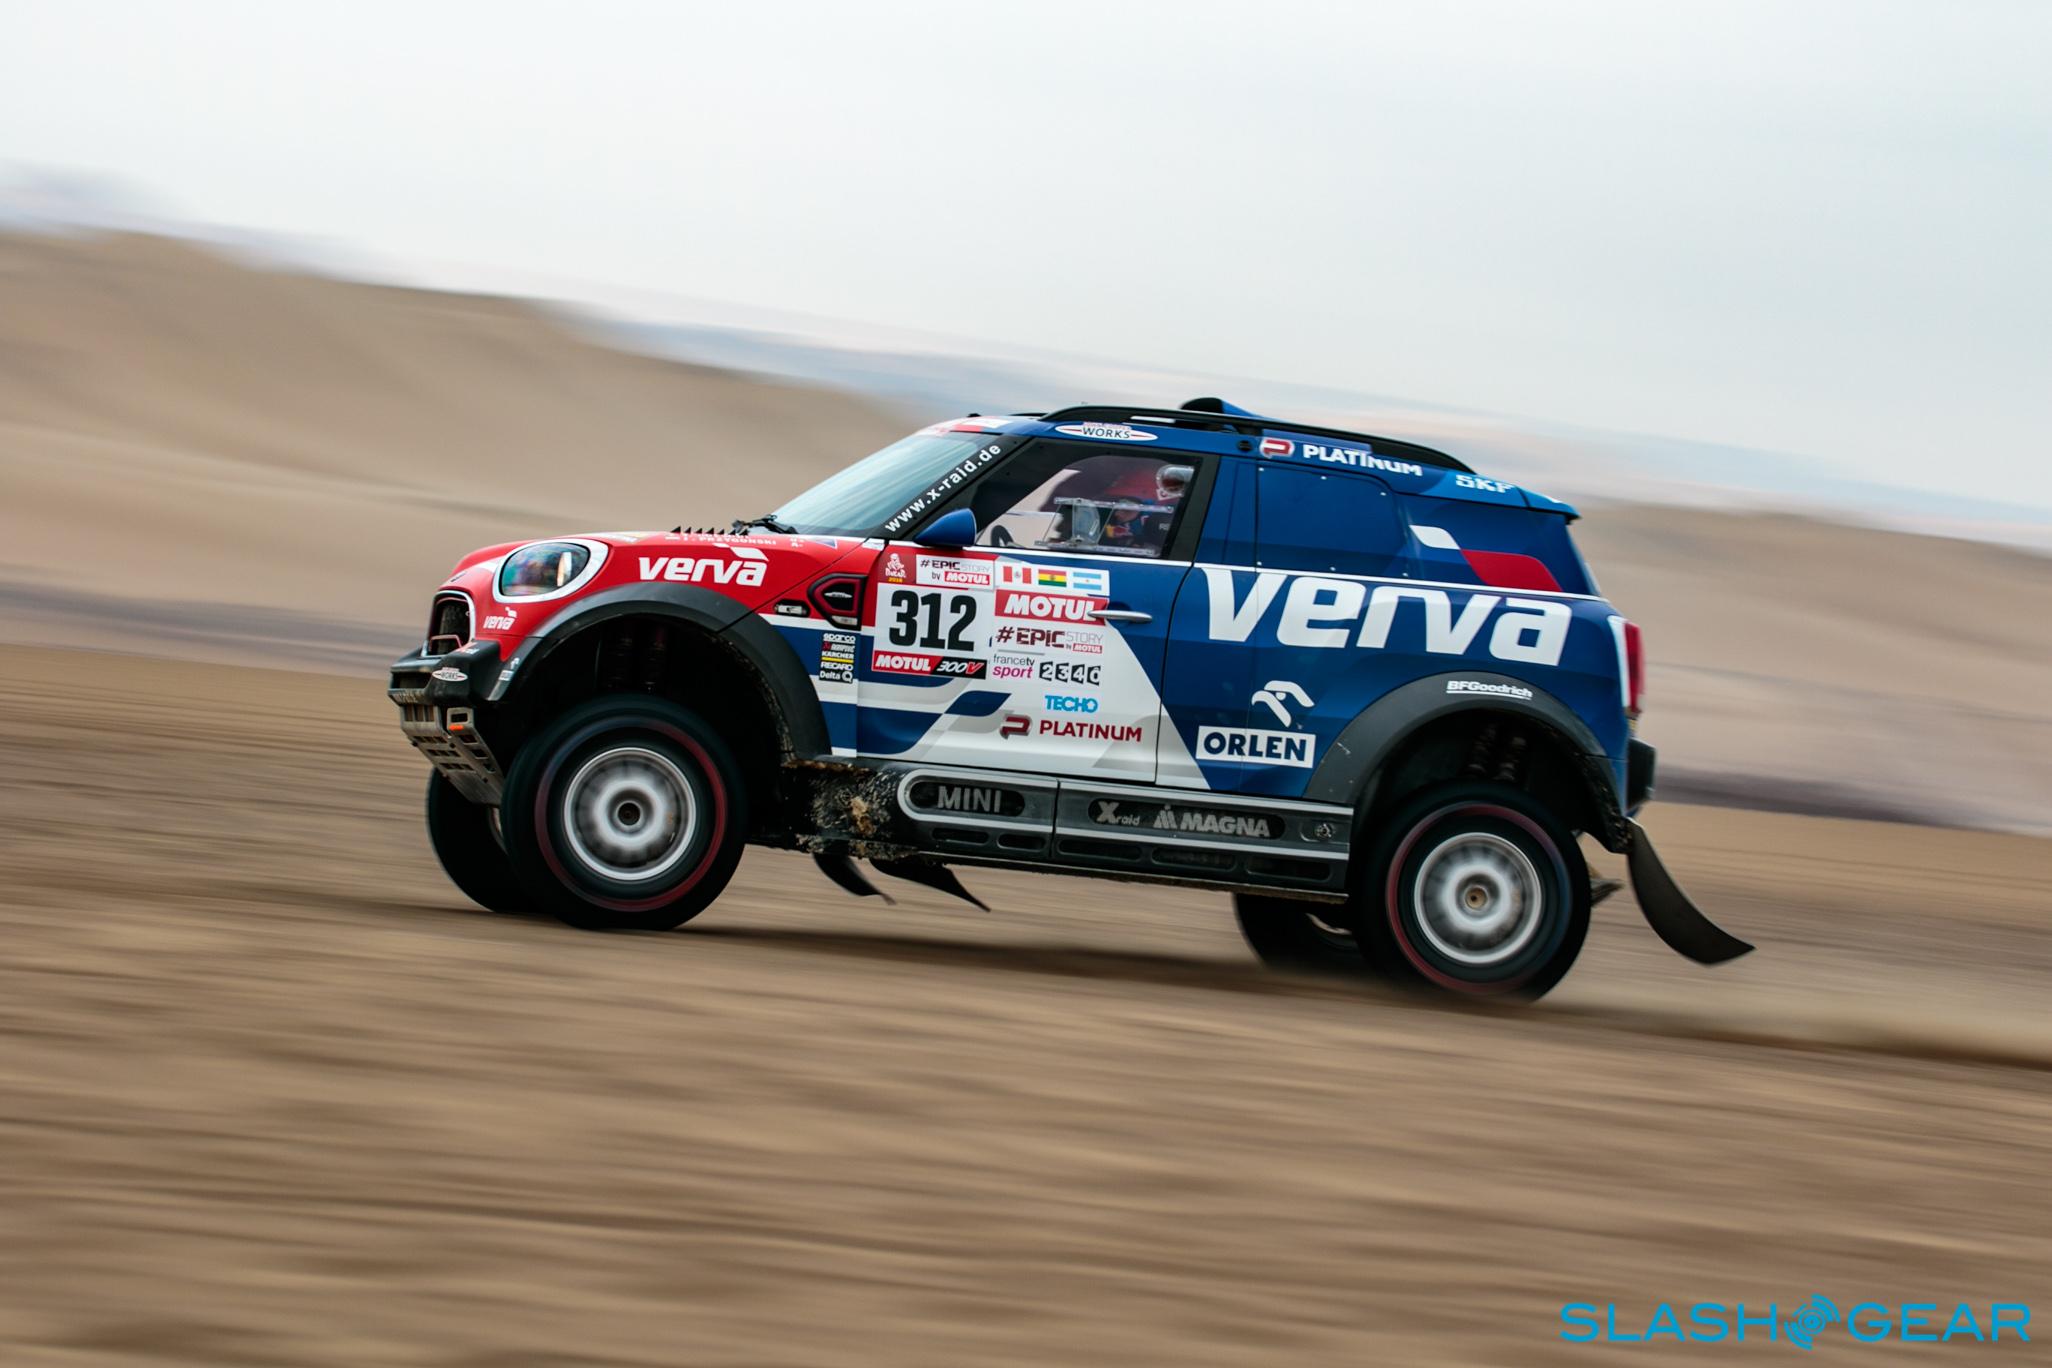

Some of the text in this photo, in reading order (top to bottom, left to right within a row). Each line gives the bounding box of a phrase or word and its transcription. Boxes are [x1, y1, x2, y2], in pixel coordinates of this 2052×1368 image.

[1083, 427, 1130, 438] WORKS
[1303, 444, 1423, 476] PLATINUM
[884, 444, 1001, 532] www.x-raid.de
[1456, 474, 1514, 493] SKF
[638, 556, 768, 587] verva
[931, 572, 989, 585] by MOTUL
[1003, 593, 1097, 621] MOTUL
[1201, 566, 1572, 666] verva
[889, 590, 977, 651] 312
[1073, 644, 1102, 653] MOTUL
[821, 662, 853, 671] RECARO
[875, 655, 984, 674] MOTUL 300V
[993, 665, 1032, 678] sport
[820, 671, 853, 683] Delta Q
[1447, 680, 1533, 697] BFGoodrich
[1045, 695, 1098, 713] TECHO
[1040, 720, 1142, 742] PLATINUM
[1203, 731, 1306, 762] ORLEN
[938, 786, 1001, 813] MINI
[1180, 813, 1270, 838] MAGNA
